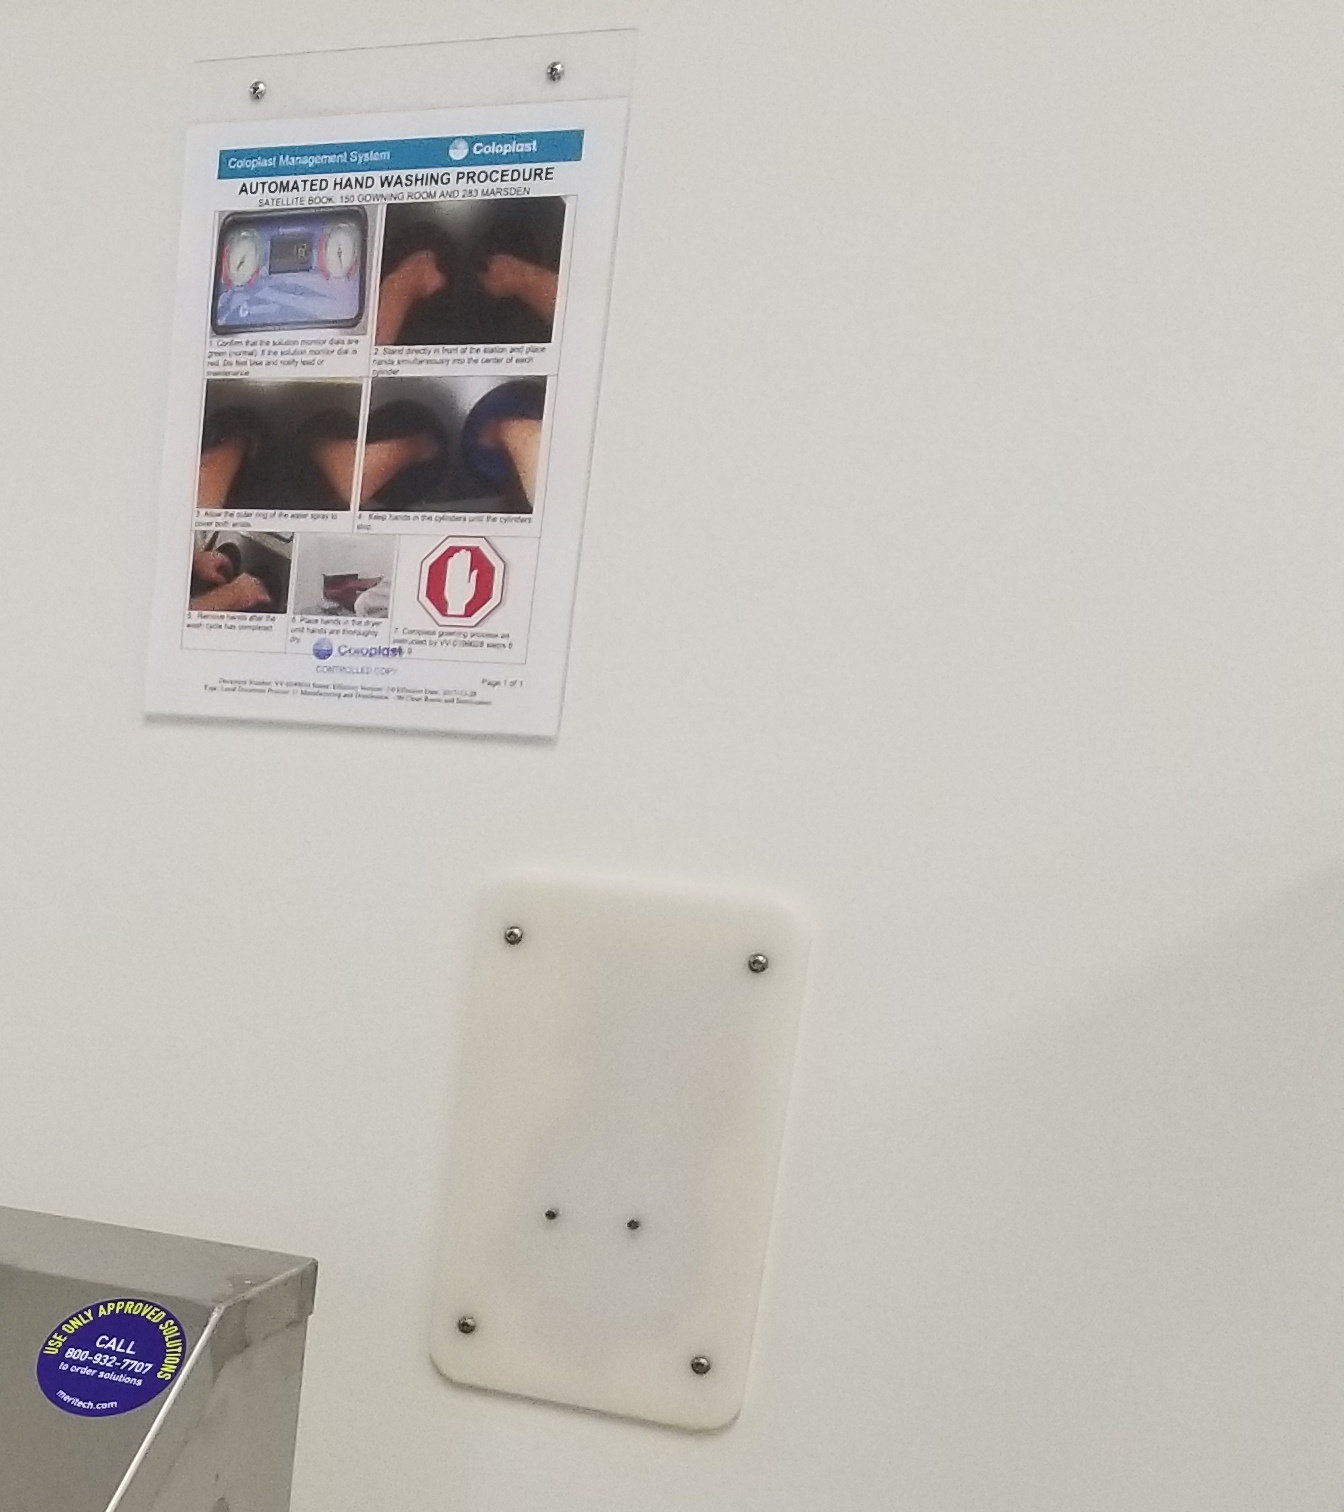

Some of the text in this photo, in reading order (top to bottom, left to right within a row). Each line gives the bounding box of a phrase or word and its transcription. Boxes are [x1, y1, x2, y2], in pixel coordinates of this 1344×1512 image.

[472, 140, 537, 155] Coloplast
[228, 150, 390, 170] Coloplast Management System
[238, 167, 555, 195] AUTOMATED HAND WASHING PROCEDURE
[258, 196, 305, 207] SATELLITE
[340, 194, 355, 203] 150
[407, 190, 436, 200] ROOM
[439, 189, 459, 198] AND
[481, 187, 531, 197] MARSDEN
[43, 1301, 183, 1381] USE ONLY APPROVED SOLUTIONS
[96, 1335, 136, 1355] CALL
[64, 1347, 154, 1375] 800-932-7707
[58, 1361, 143, 1387] to order solutions
[56, 1389, 118, 1410] meritech.com
